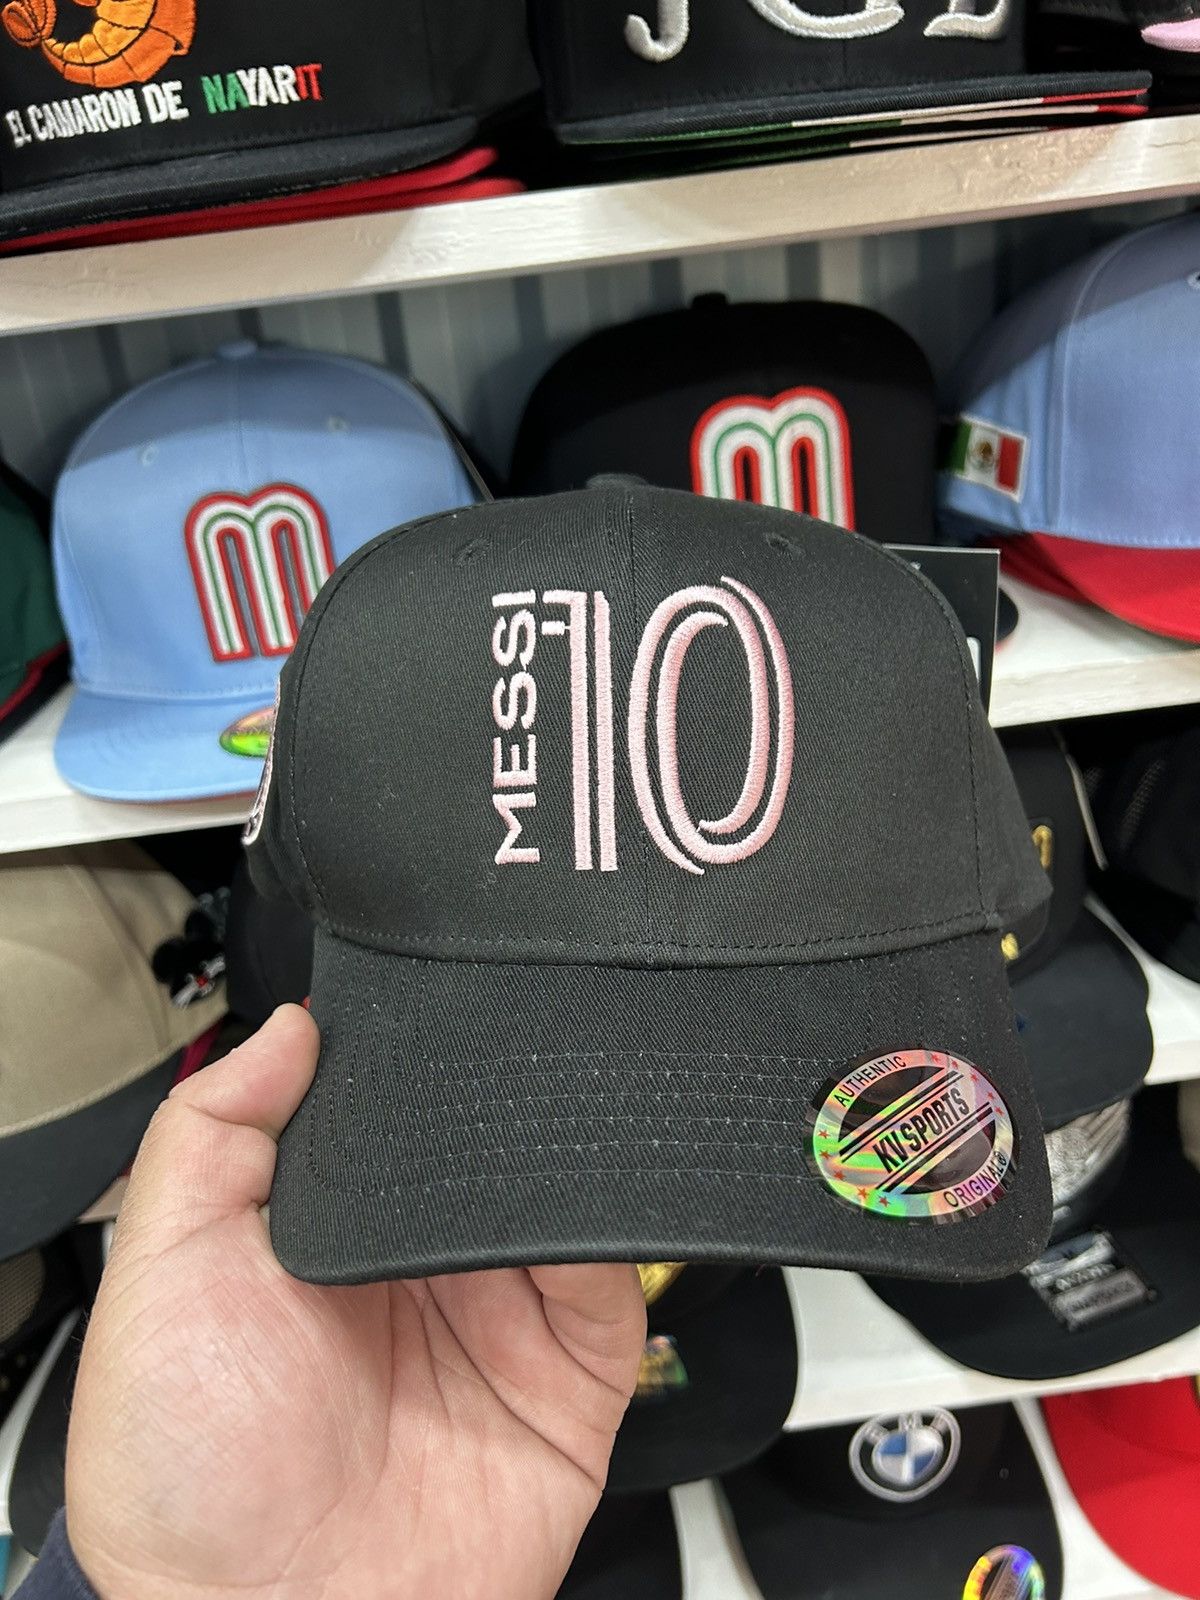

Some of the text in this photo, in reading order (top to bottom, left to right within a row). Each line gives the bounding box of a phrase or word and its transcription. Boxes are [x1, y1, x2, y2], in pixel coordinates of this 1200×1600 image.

[5, 64, 323, 148] EL CAMARON DE NAYARIT
[492, 589, 539, 865] MESSI
[541, 576, 795, 875] 10
[834, 1055, 907, 1107] AUTHENTIC
